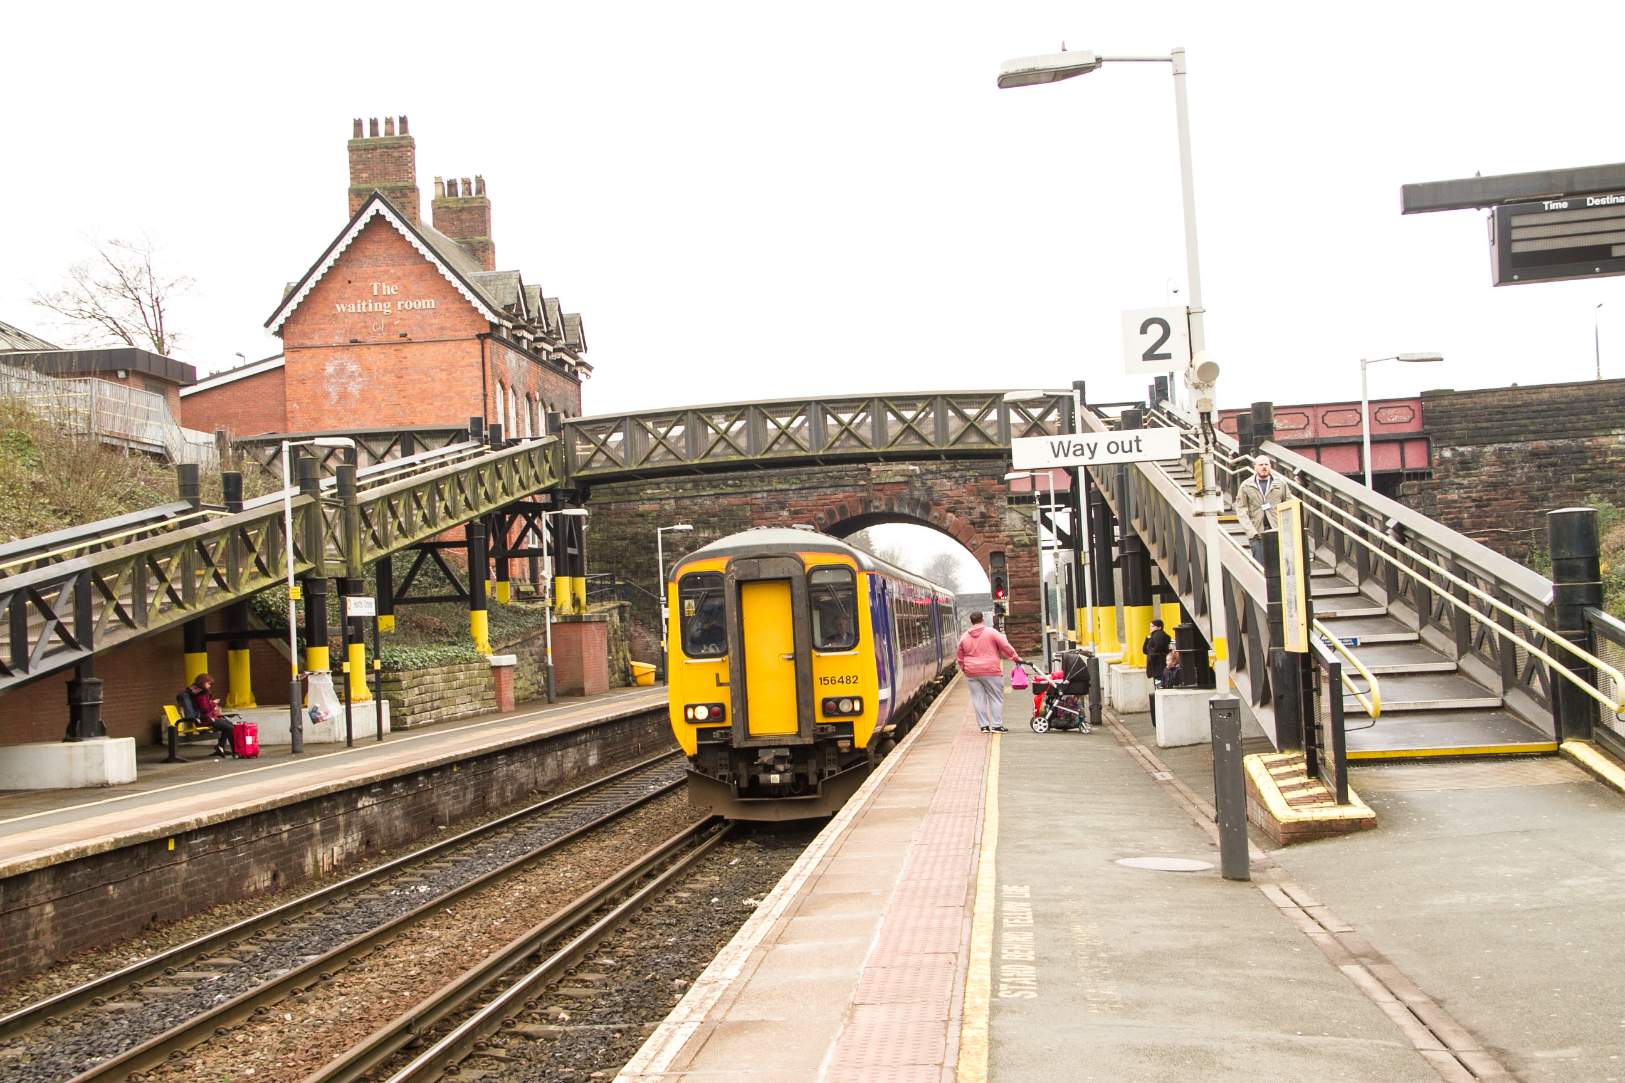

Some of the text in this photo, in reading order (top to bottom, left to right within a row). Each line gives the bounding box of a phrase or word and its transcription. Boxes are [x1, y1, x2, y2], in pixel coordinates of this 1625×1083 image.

[1542, 195, 1625, 211] Time Destina
[371, 283, 399, 295] The
[335, 299, 436, 315] waiting room
[1139, 317, 1172, 361] 2
[1050, 435, 1143, 459] Way out
[819, 675, 858, 685] 156482
[1001, 931, 1035, 961] BEHIND
[998, 964, 1038, 999] STAND
